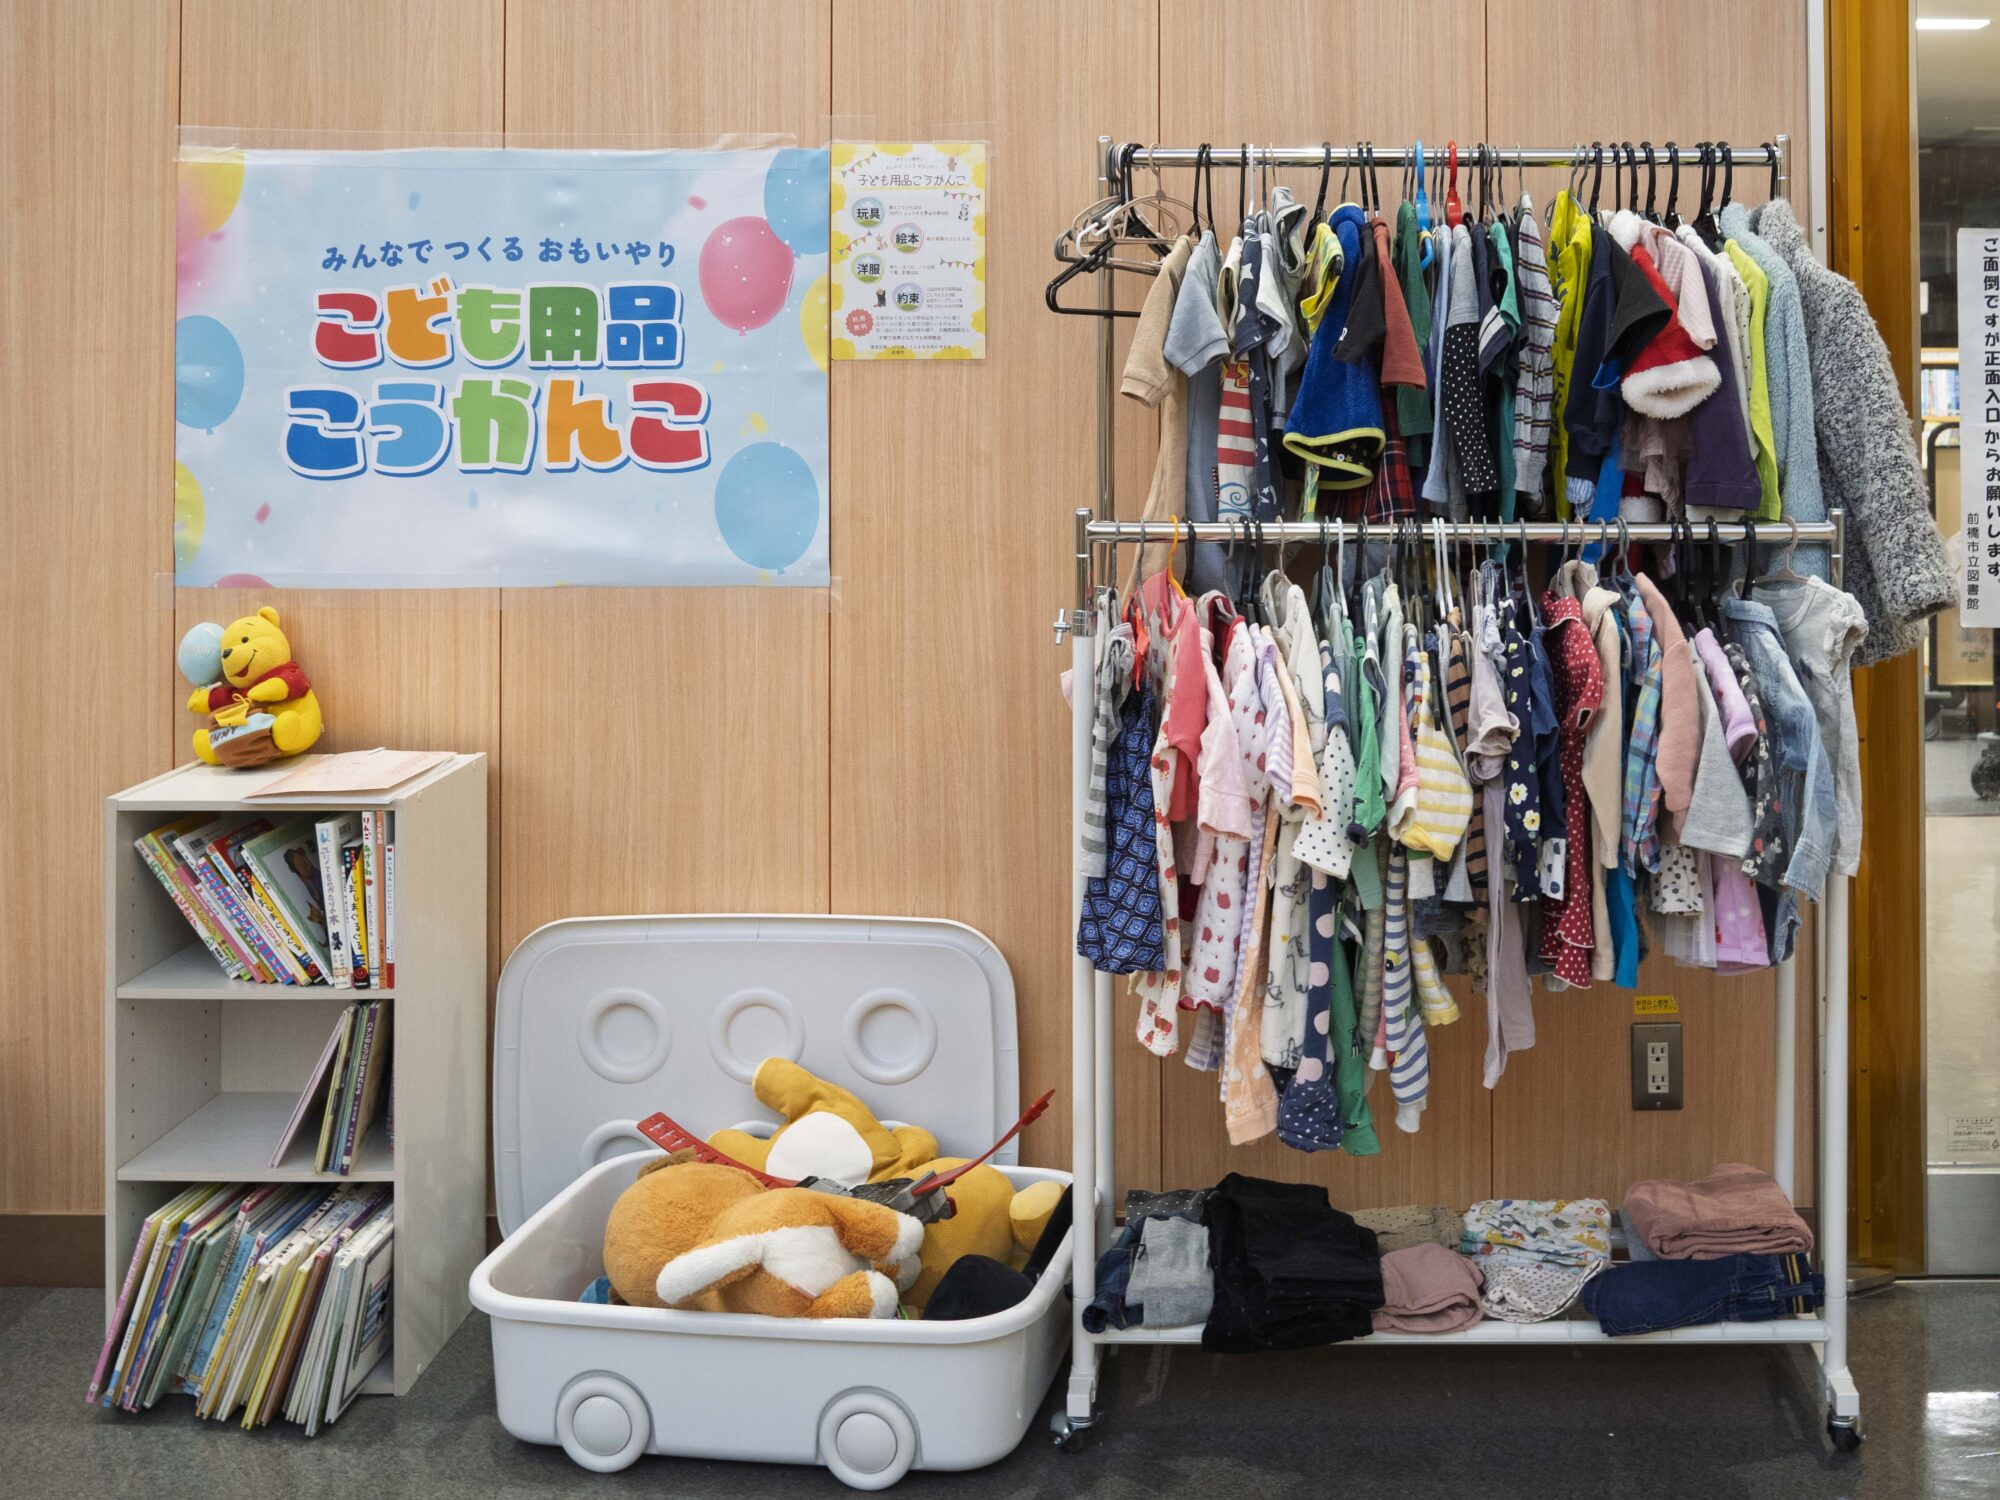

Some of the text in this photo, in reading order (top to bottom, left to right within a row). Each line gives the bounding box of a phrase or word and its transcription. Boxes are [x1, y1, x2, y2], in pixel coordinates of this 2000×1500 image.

[858, 174, 966, 187] 子ども用品こうかんこ
[856, 207, 881, 220] 玩具
[321, 235, 677, 272] みんなで つくる おもいやり
[895, 232, 920, 244] 絵本
[857, 263, 881, 275] 洋服
[312, 273, 684, 368] こども用品
[896, 292, 920, 304] 約束
[284, 376, 710, 478] こうかんこ
[1967, 513, 1979, 610] 前橋市立図書館
[363, 817, 372, 876] りんご あげるね
[255, 890, 302, 952] しましまぐるぐる
[348, 874, 363, 950] しましまぐるぐる
